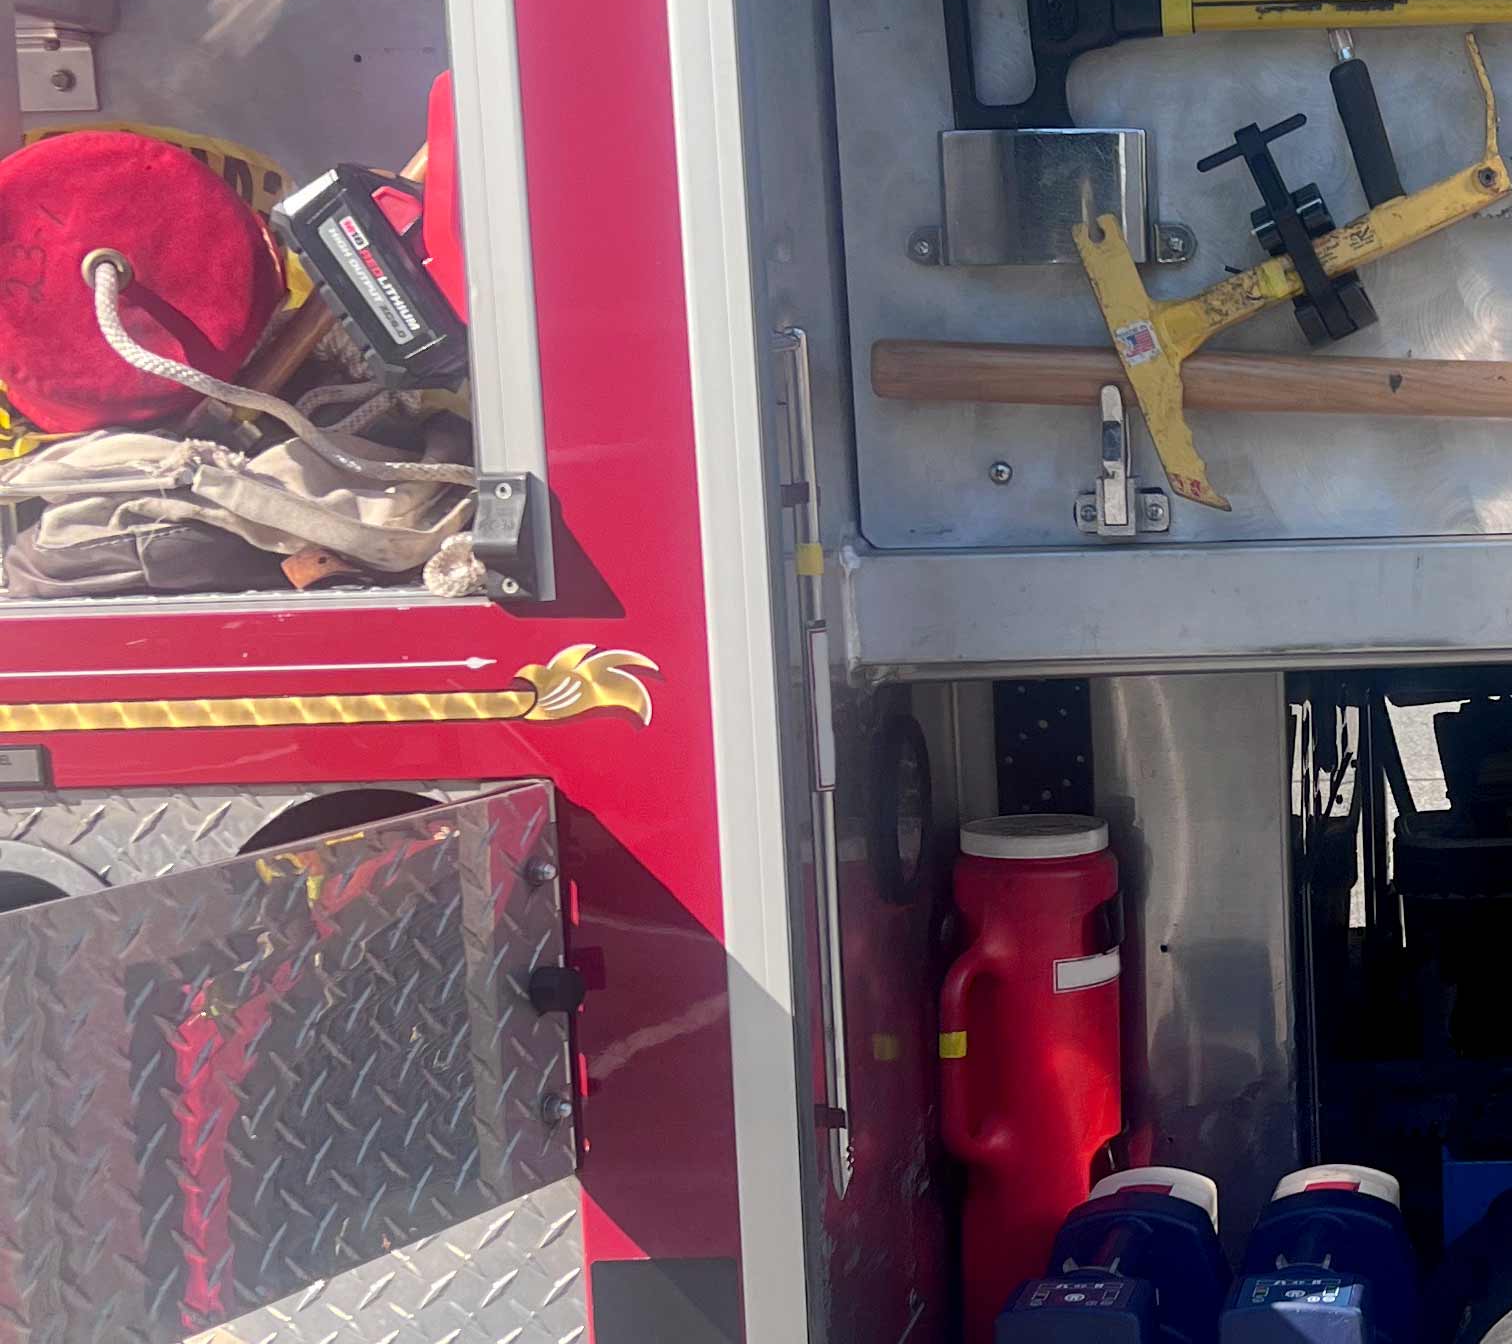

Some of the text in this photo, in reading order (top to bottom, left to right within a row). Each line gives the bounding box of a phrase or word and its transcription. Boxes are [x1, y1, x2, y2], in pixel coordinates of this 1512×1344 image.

[328, 228, 352, 258] HIGH
[349, 260, 384, 304] OUTPUT
[342, 219, 420, 331] M18 REDLITHIUM
